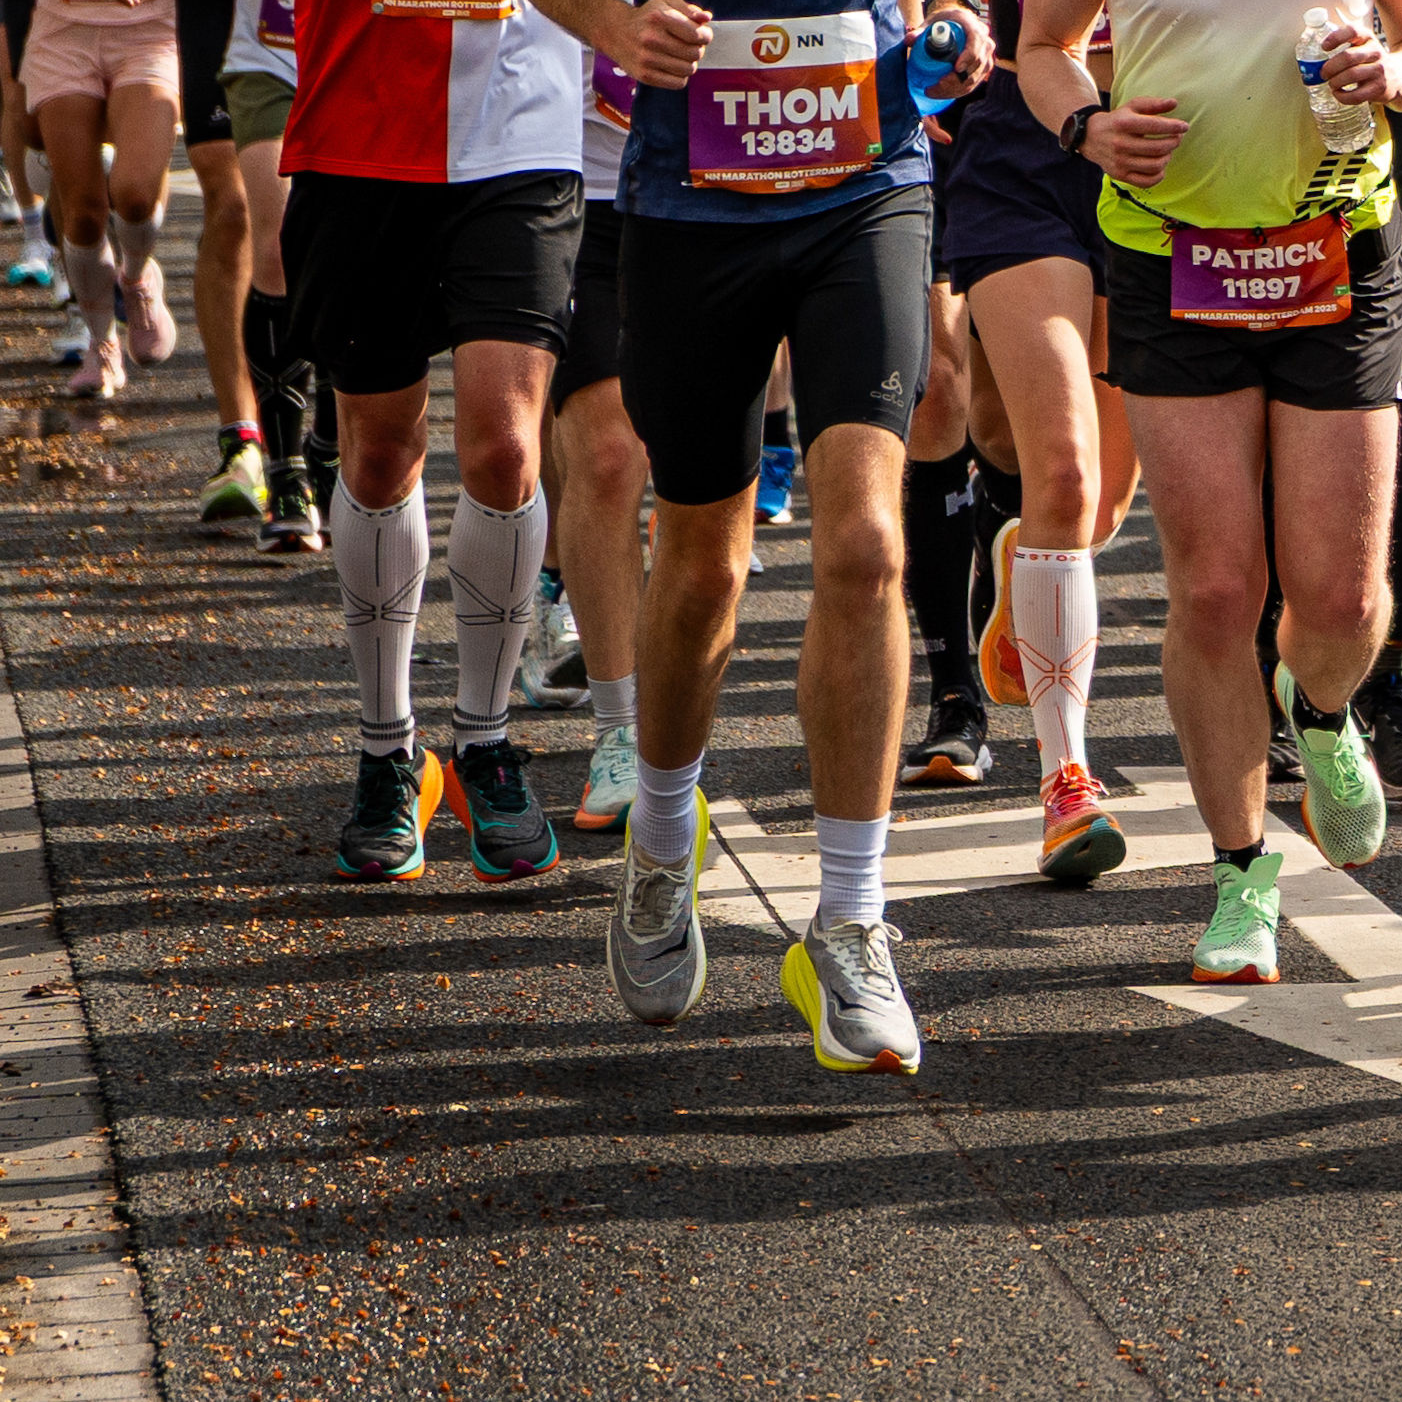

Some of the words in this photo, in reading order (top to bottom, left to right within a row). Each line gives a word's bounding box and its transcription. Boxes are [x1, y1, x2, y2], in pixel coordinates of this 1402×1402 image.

[397, 0, 449, 9] MARATHON
[797, 34, 824, 48] NN
[713, 84, 859, 126] THOM
[741, 127, 835, 156] 13834
[704, 172, 721, 181] NN
[722, 170, 783, 181] MARATHON
[784, 166, 845, 180] ROTTERDAM
[1192, 238, 1326, 270] PATRICK
[1222, 275, 1301, 299] 11897
[1184, 312, 1200, 320] NN
[1200, 311, 1256, 321] MARATHON
[1256, 306, 1314, 321] ROTTERDAM
[1314, 303, 1338, 314] 2025
